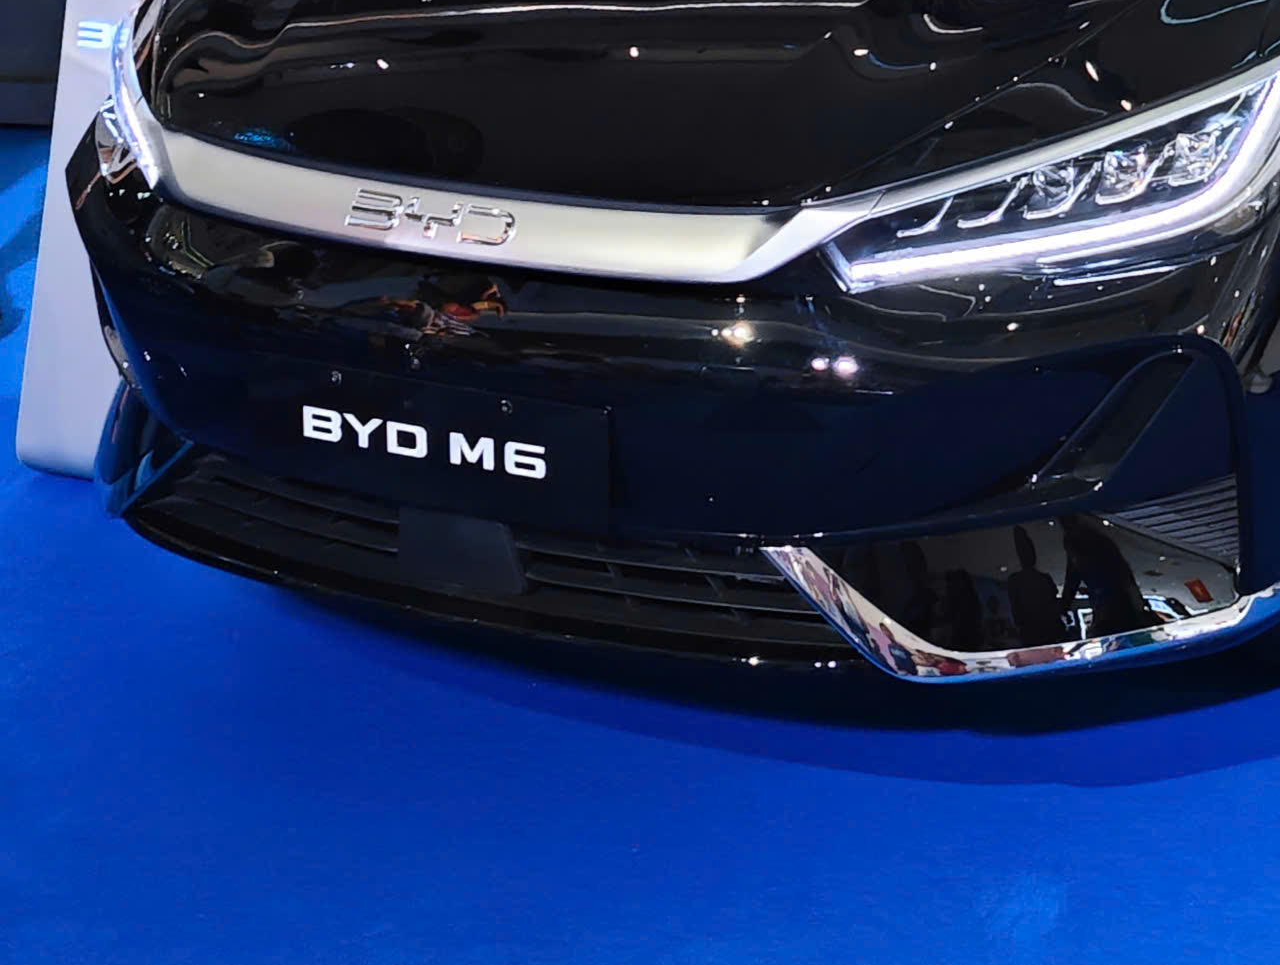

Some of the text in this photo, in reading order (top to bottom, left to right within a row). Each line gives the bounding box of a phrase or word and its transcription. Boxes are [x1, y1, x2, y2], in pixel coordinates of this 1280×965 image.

[345, 187, 518, 247] BYD
[302, 404, 547, 479] BYD M6
